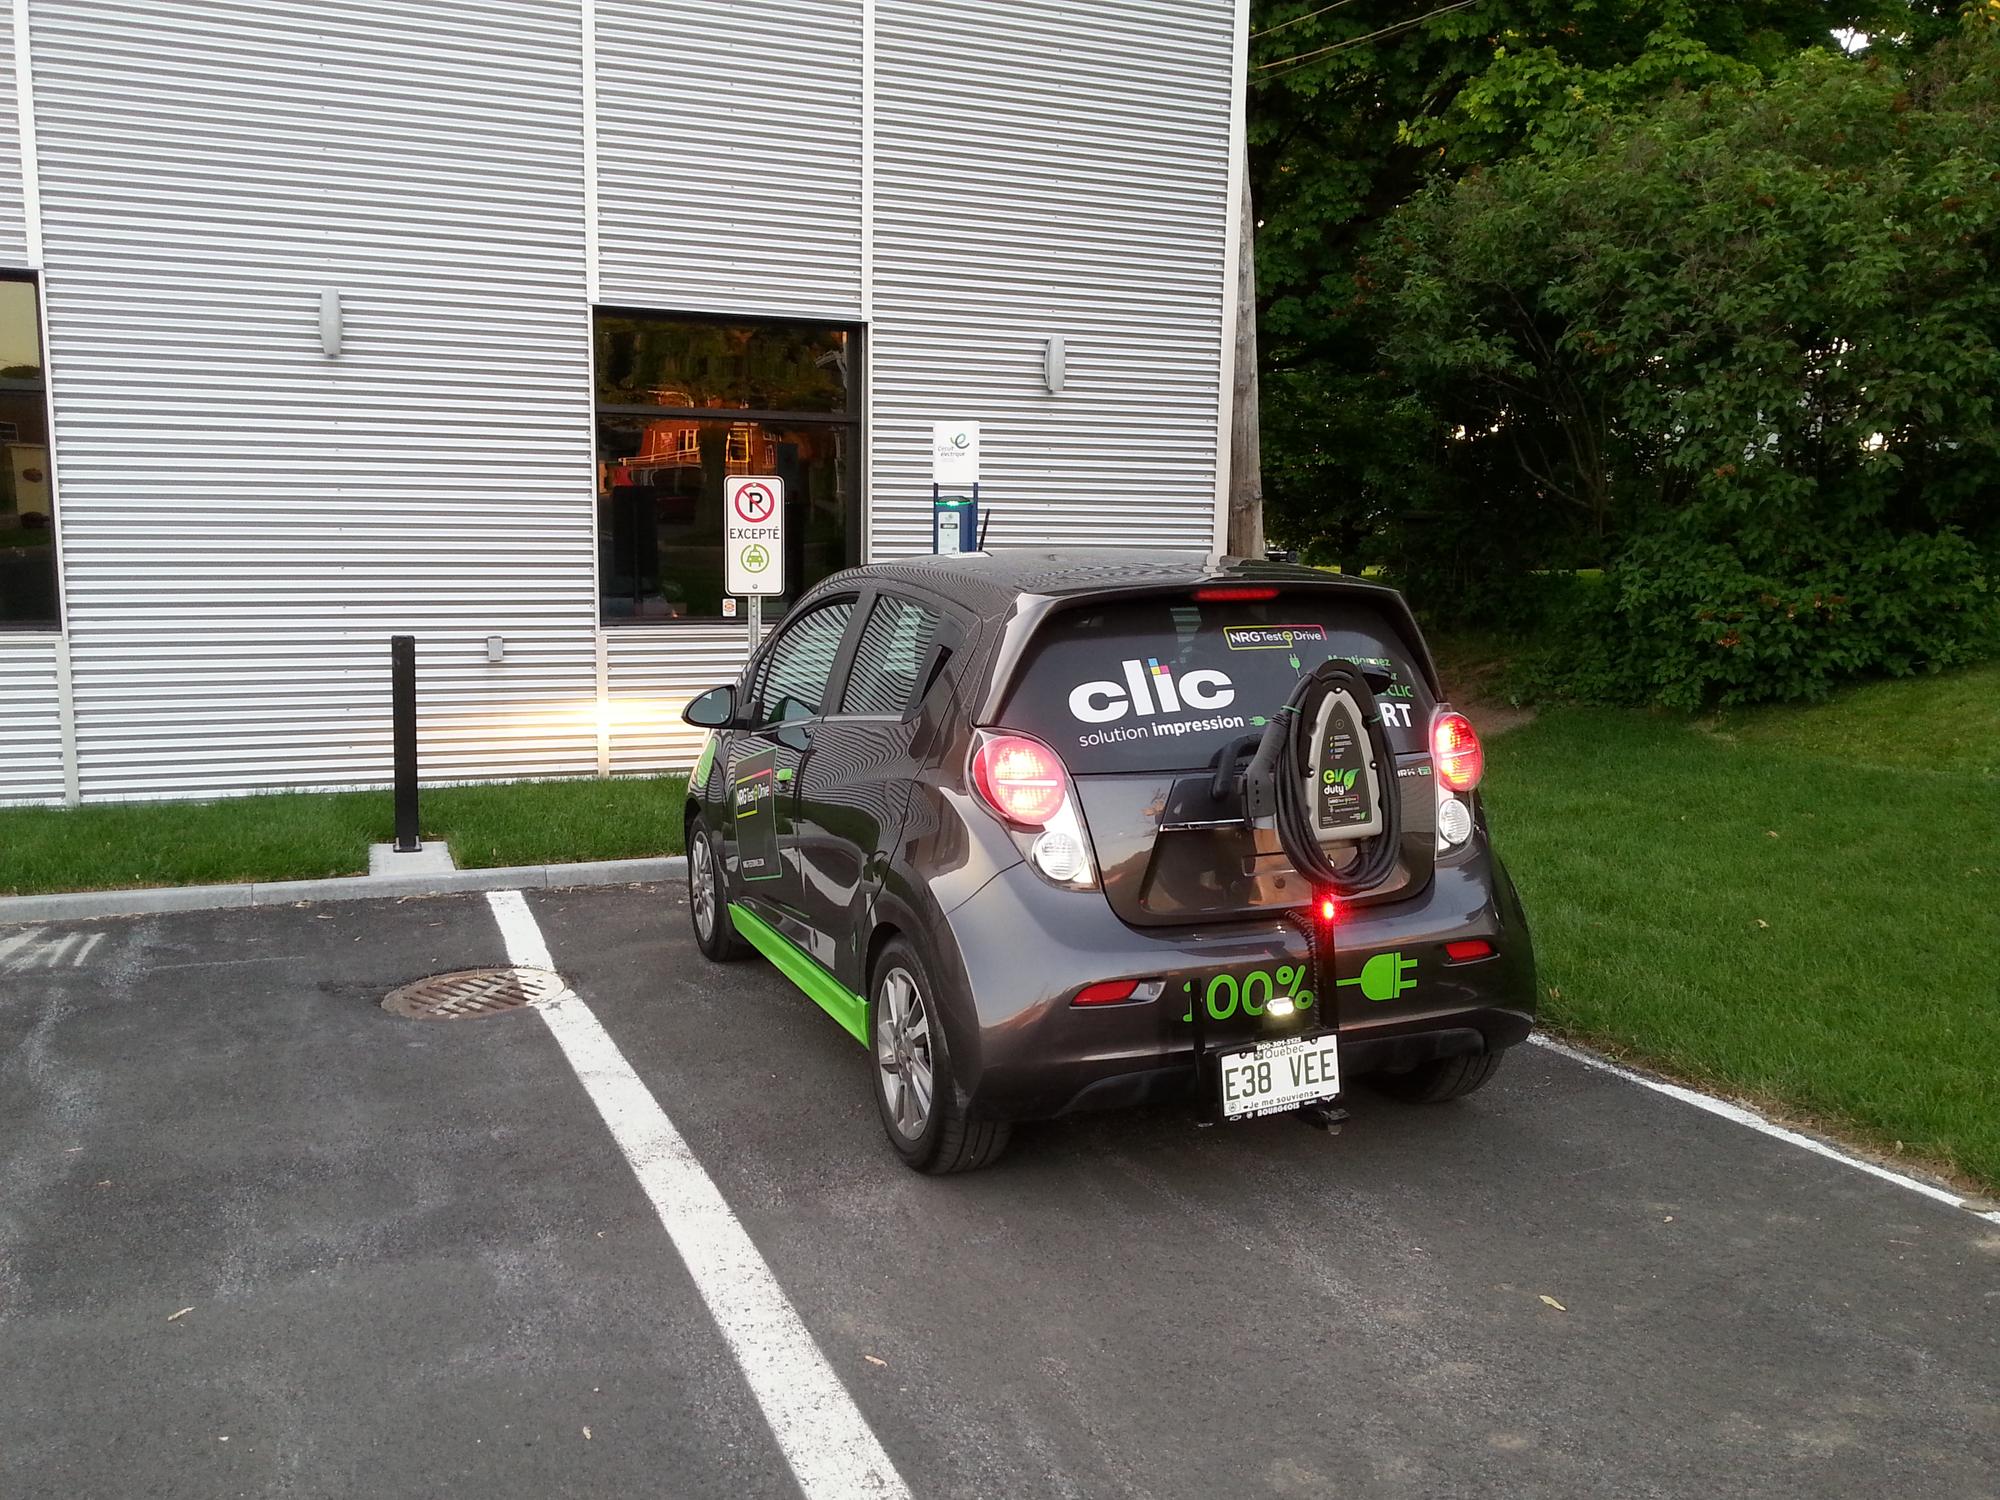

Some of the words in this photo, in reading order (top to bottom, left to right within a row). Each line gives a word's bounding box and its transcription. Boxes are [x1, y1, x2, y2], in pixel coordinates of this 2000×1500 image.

[749, 492, 763, 513] P
[729, 526, 780, 540] EXCEPTÉ
[1293, 631, 1322, 641] Drive
[1068, 657, 1235, 724] clic
[1379, 702, 1412, 728] RT
[1079, 725, 1149, 747] solution
[1151, 715, 1245, 737] impression
[1323, 784, 1345, 796] duty
[1225, 1061, 1272, 1102] E38
[1289, 1048, 1336, 1088] VEE
[1262, 1097, 1274, 1107] me
[1277, 1090, 1315, 1104] souviens
